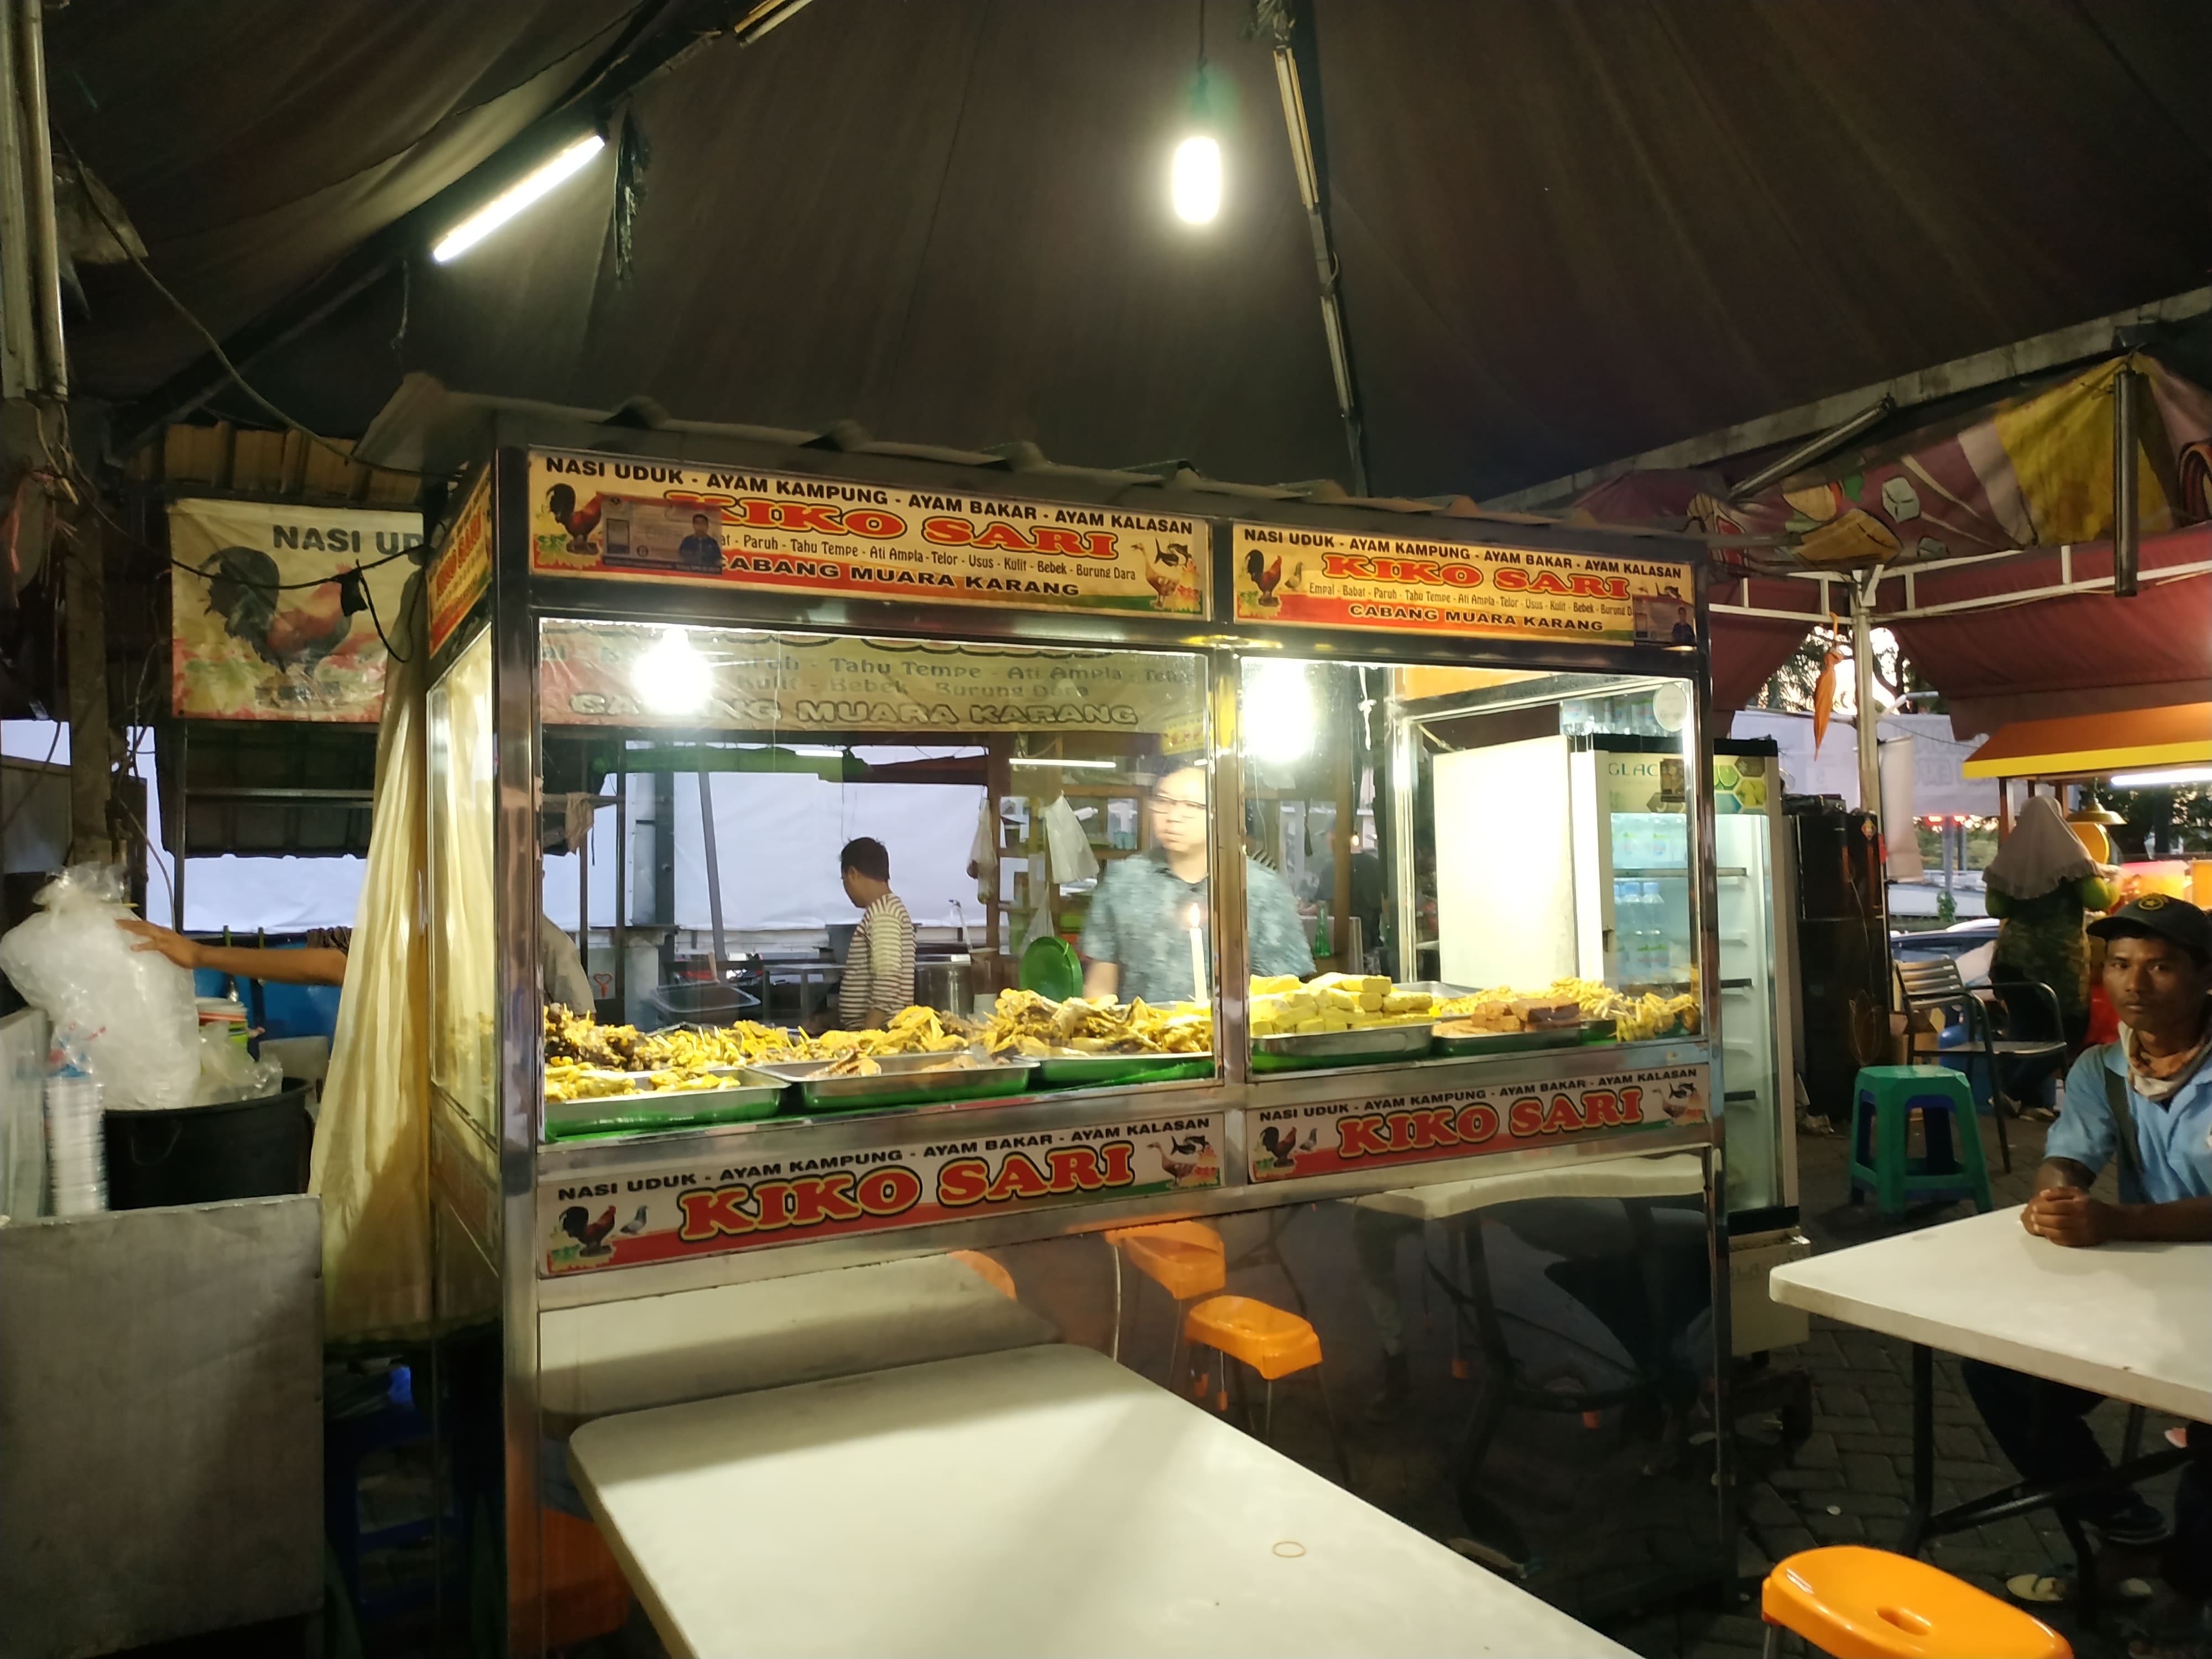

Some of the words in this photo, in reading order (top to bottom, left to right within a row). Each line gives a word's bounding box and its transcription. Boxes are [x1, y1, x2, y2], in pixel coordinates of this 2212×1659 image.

[546, 457, 604, 477] NASI
[614, 463, 684, 485] UDUK
[707, 473, 768, 493] AYAM
[776, 481, 888, 504] KAMPUNG
[908, 494, 962, 513] AYAM
[970, 499, 1037, 520] BAKAR
[1055, 510, 1105, 526] AYAM
[1111, 515, 1193, 534] KALASAN
[273, 525, 360, 552] NASI
[744, 534, 778, 550] Paruh
[790, 539, 817, 553] Tahu
[822, 542, 858, 556] Tempe
[870, 546, 885, 559] Ati
[889, 549, 924, 564] Ampla
[931, 551, 958, 566] Telor
[969, 555, 994, 570] Usus
[1004, 557, 1027, 571] Kulit
[1037, 560, 1067, 576] Bebek
[1076, 564, 1110, 579] Burung
[1114, 567, 1136, 581] Dara
[922, 515, 1119, 560] SARI
[1244, 529, 1283, 544] NASI
[1290, 533, 1334, 547] UDUK
[1350, 538, 1390, 553] AYAM
[1395, 542, 1470, 560] KAMPUNG
[1484, 550, 1520, 564] AYAM
[1526, 554, 1572, 568] BAKAR
[1584, 559, 1619, 573] AYAM
[1623, 562, 1682, 579] KALASAN
[851, 566, 954, 587] MUARA
[965, 576, 1079, 596] KARANG
[1310, 582, 1334, 594] Empal
[1343, 585, 1365, 597] Babat
[1374, 587, 1397, 599] Paruh
[1405, 589, 1423, 601] Tahu
[1426, 591, 1451, 603] Tempe
[1458, 593, 1469, 604] Ati
[1472, 594, 1495, 607] Ampla
[1500, 596, 1519, 607] Telor
[1526, 598, 1543, 609] Usus
[1550, 600, 1566, 611] Kulit
[1573, 602, 1594, 613] Bebek
[1601, 604, 1625, 615] Burung
[1322, 552, 1484, 587] KIKO
[1493, 565, 1632, 599] SARI
[1350, 605, 1438, 620] CABANG
[1446, 611, 1516, 625] MUARA
[1524, 616, 1603, 631] KARANG
[831, 658, 891, 675] Tahu
[902, 661, 981, 679] Tempe
[1008, 666, 1041, 679] Ati
[570, 692, 781, 719] CANG
[796, 700, 959, 724] MUARA
[969, 703, 1138, 724] KARANG
[1608, 763, 1659, 776] GLAC
[1259, 1109, 1298, 1123] NASI
[1304, 1103, 1350, 1117] UDUK
[1364, 1097, 1406, 1112] AYAM
[1411, 1088, 1487, 1105] KAMPUNG
[1500, 1083, 1536, 1097] AYAM
[1540, 1079, 1586, 1093] BAKAR
[1598, 1074, 1632, 1087] AYAM
[1637, 1068, 1697, 1083] KALASAN
[1337, 1103, 1499, 1160] KIKO
[1509, 1086, 1645, 1137] SARI
[559, 1183, 618, 1201] NASI
[627, 1173, 696, 1193] UDUK
[719, 1164, 781, 1181] AYAM
[789, 1150, 903, 1172] KAMPUNG
[924, 1141, 978, 1159] AYAM
[985, 1134, 1052, 1151] BAKAR
[1071, 1127, 1120, 1142] AYAM
[1127, 1118, 1209, 1136] KALASAN
[677, 1164, 922, 1244] KIKO
[936, 1140, 1135, 1207] SARI
